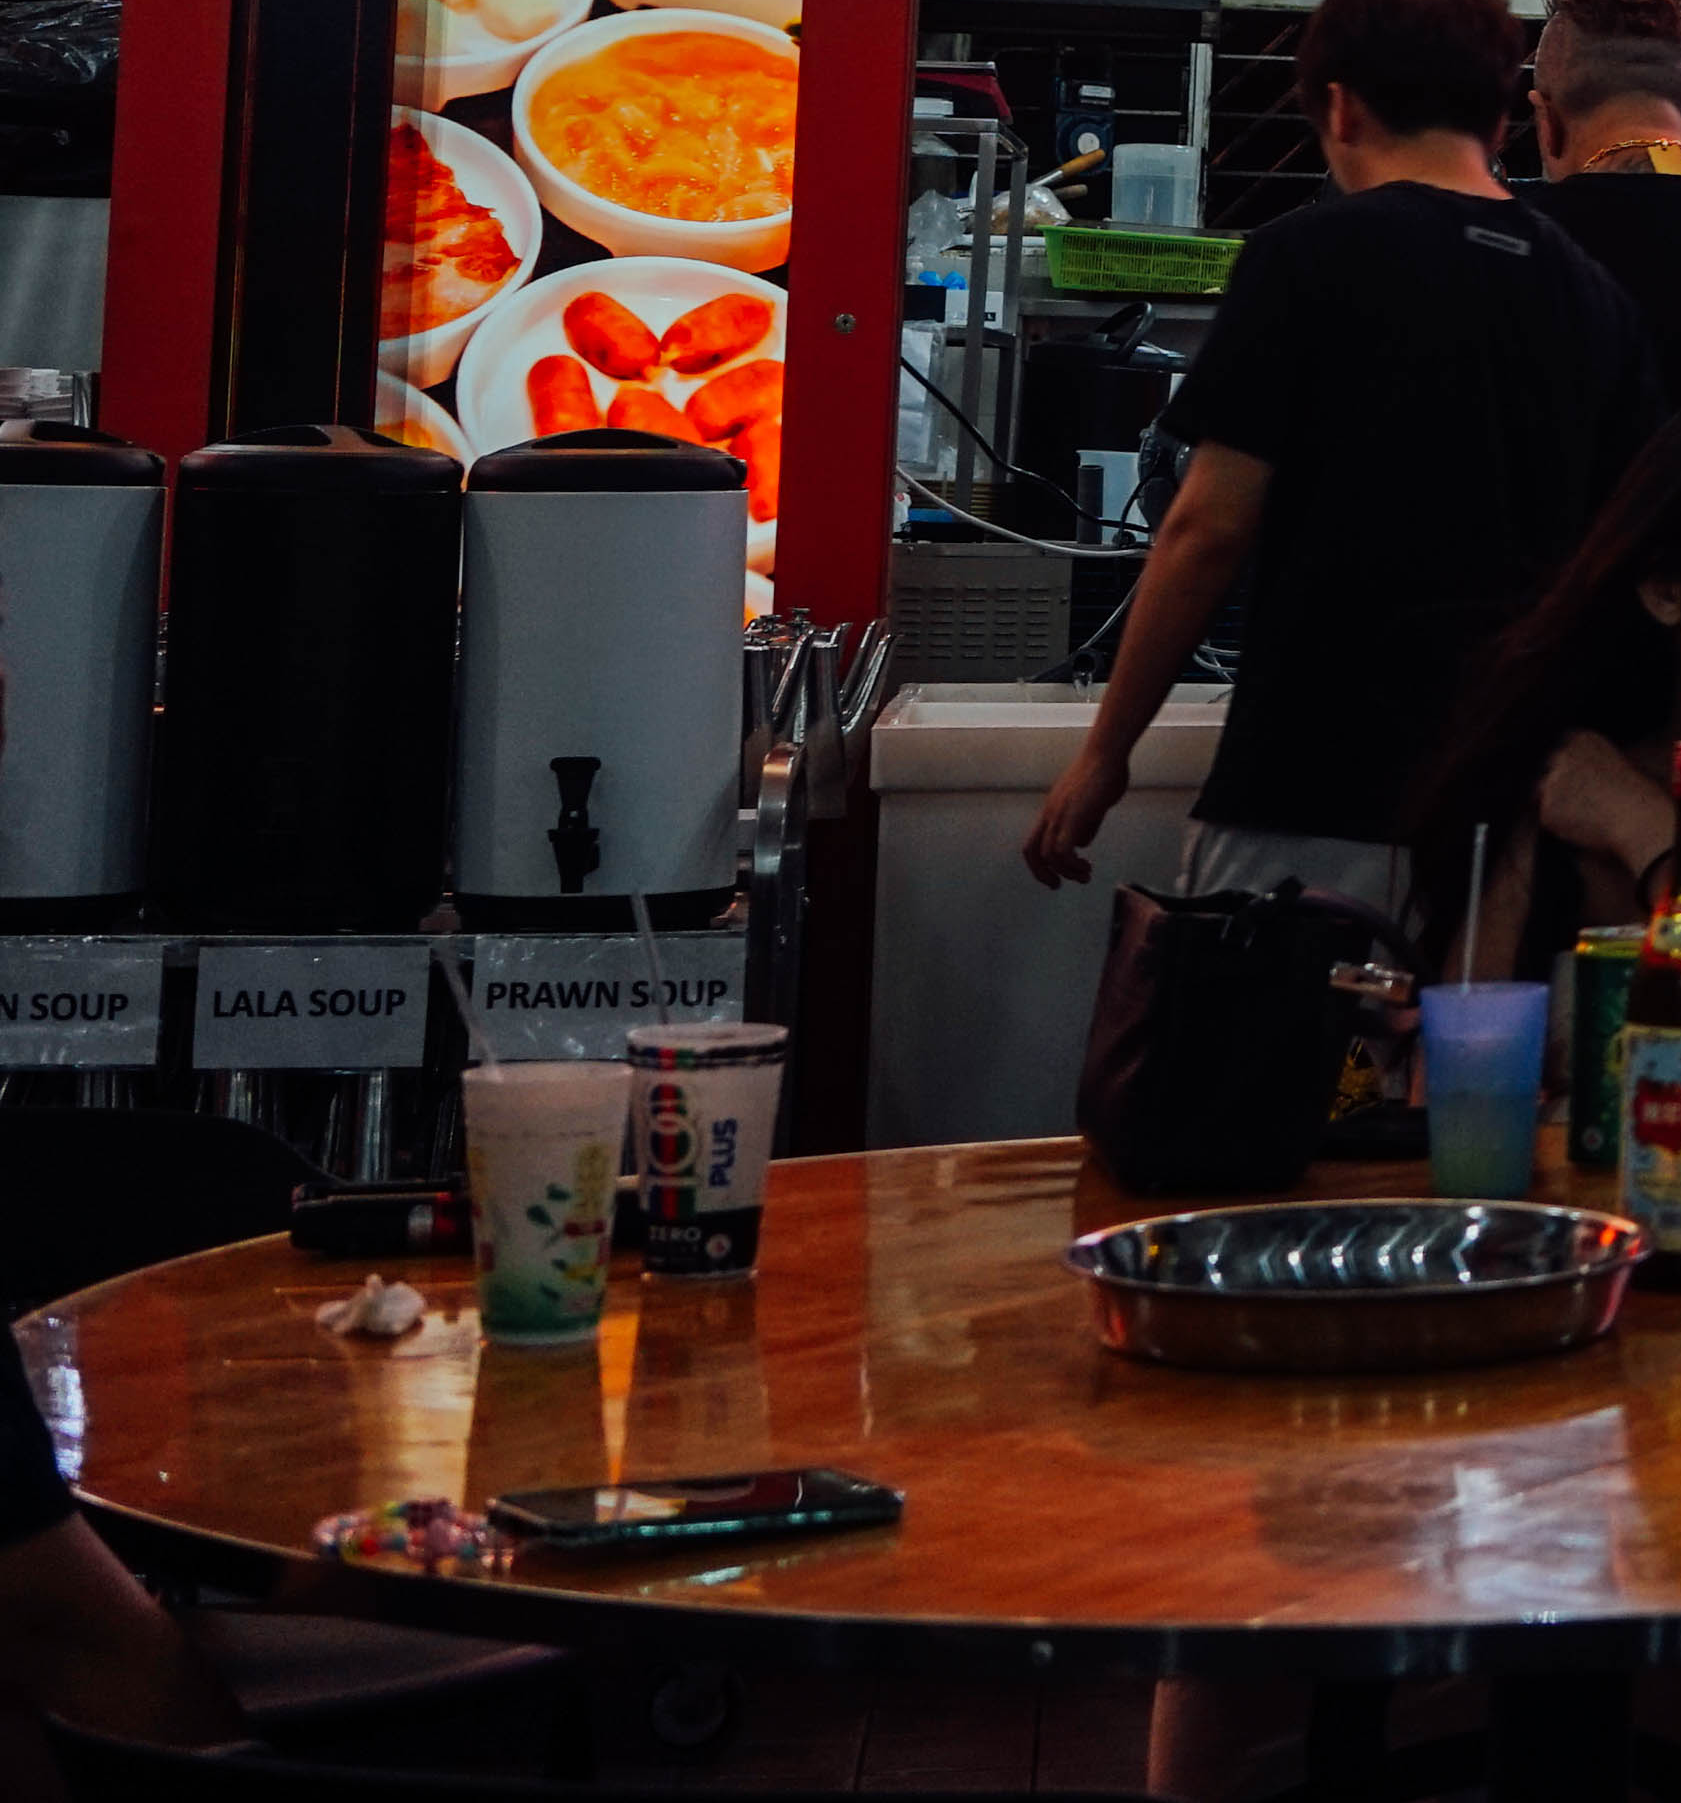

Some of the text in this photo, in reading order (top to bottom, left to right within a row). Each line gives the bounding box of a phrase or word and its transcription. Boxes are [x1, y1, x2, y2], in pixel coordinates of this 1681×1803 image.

[29, 993, 129, 1021] SOUP
[212, 988, 407, 1018] LALA SOUP
[486, 981, 620, 1010] PRAWN
[709, 1118, 737, 1187] PLUS
